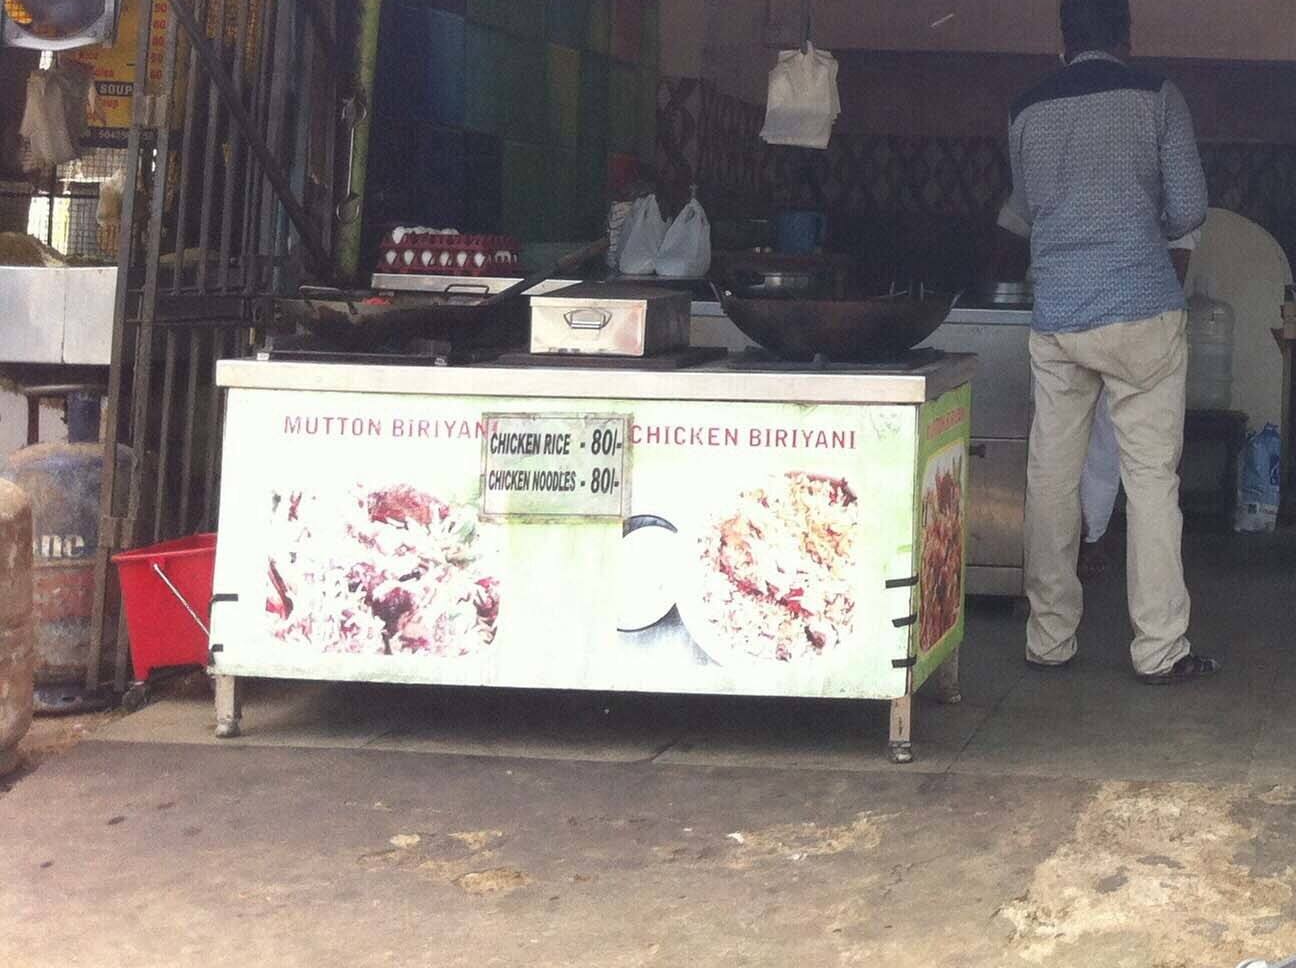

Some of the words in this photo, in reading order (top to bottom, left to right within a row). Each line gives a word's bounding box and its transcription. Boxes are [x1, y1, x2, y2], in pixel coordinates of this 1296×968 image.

[100, 84, 132, 96] SOUP
[284, 415, 381, 437] MUTTON
[630, 425, 739, 447] CHICKEN
[749, 428, 856, 450] BIRIYANI
[490, 432, 540, 455] CHICKEN
[543, 432, 570, 456] RICE
[591, 428, 622, 456] 80/-
[488, 469, 530, 493] CHICKEN
[532, 469, 576, 493] NOODLES
[591, 467, 619, 494] 80/-
